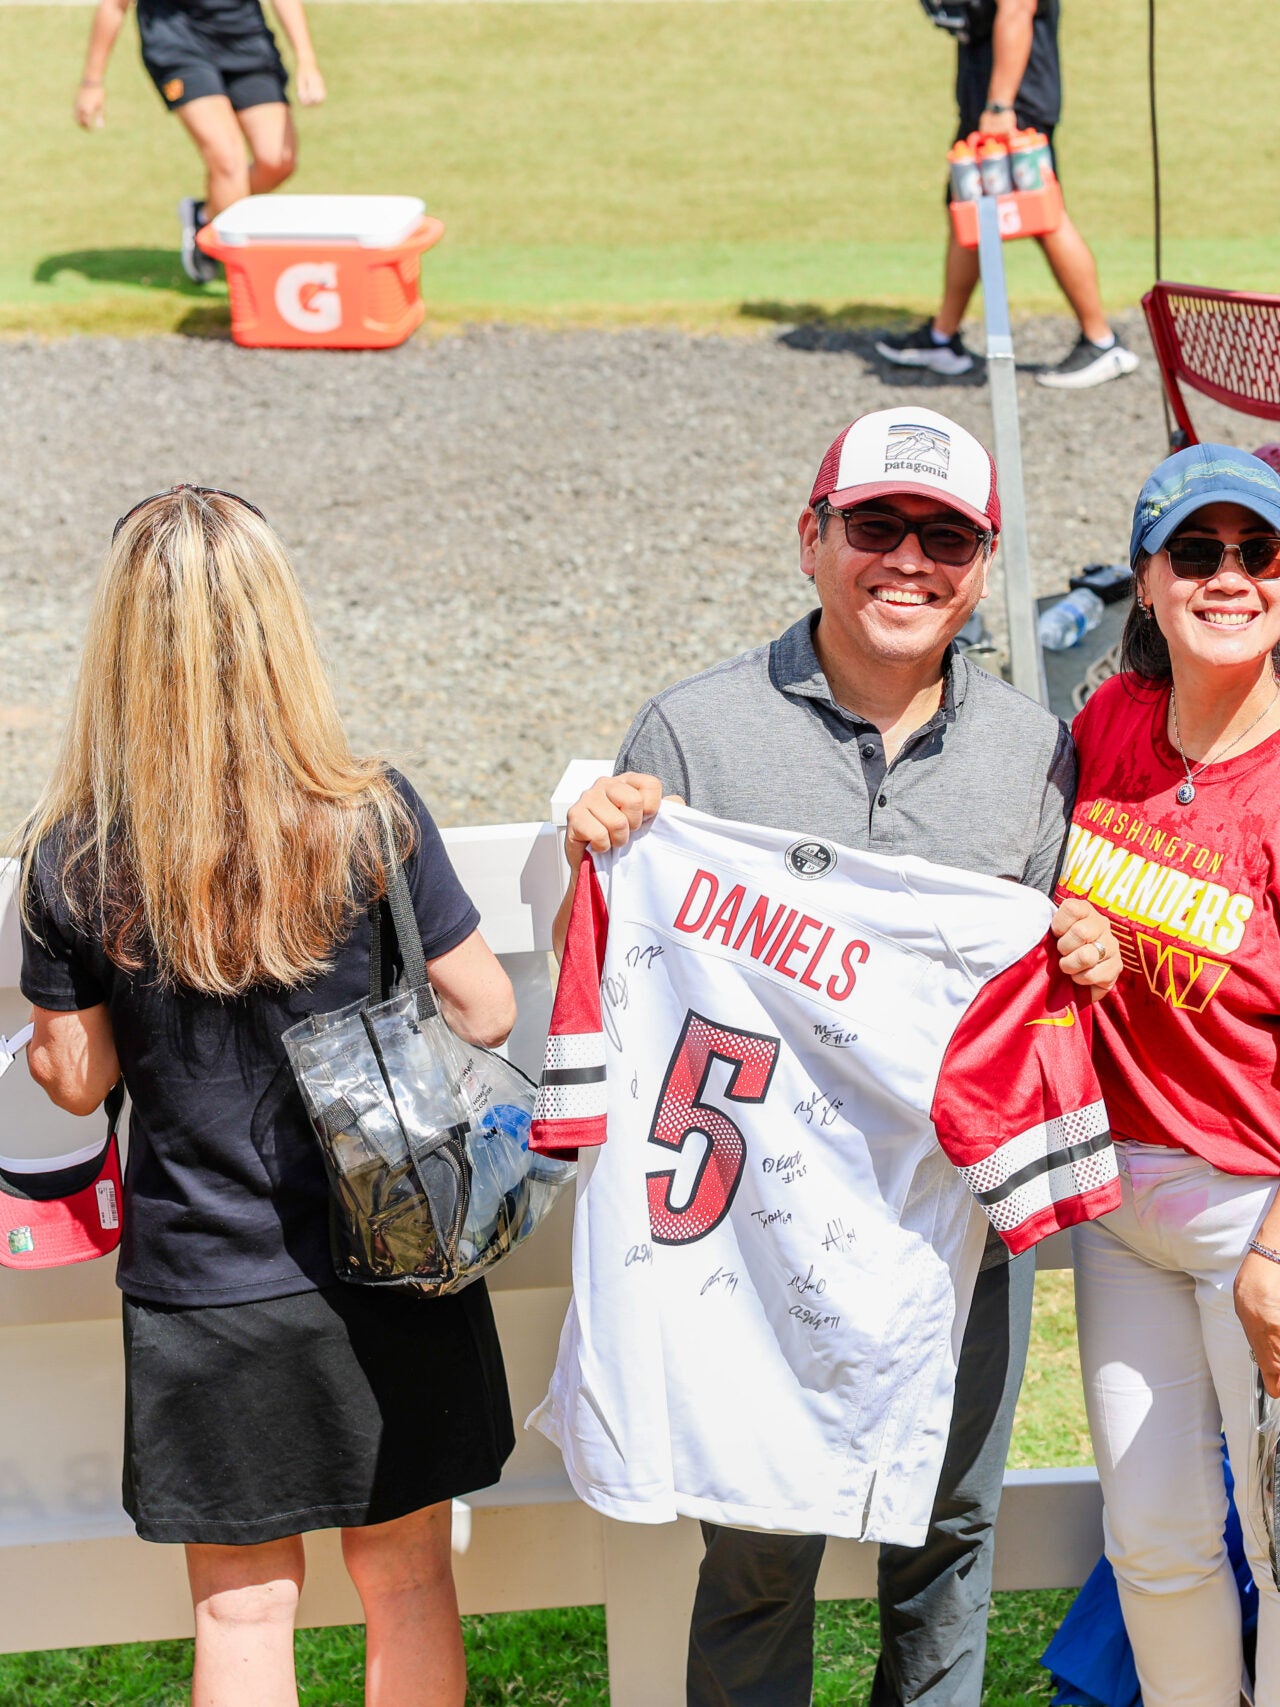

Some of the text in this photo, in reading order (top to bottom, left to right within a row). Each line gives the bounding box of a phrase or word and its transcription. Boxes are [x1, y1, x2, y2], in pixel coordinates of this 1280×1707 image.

[274, 262, 342, 333] G
[884, 461, 948, 480] patagonia
[1058, 822, 1255, 956] OMMANDERS
[1088, 800, 1225, 875] WASHINGTON
[674, 868, 871, 1001] DANIELS
[646, 1007, 781, 1247] 5
